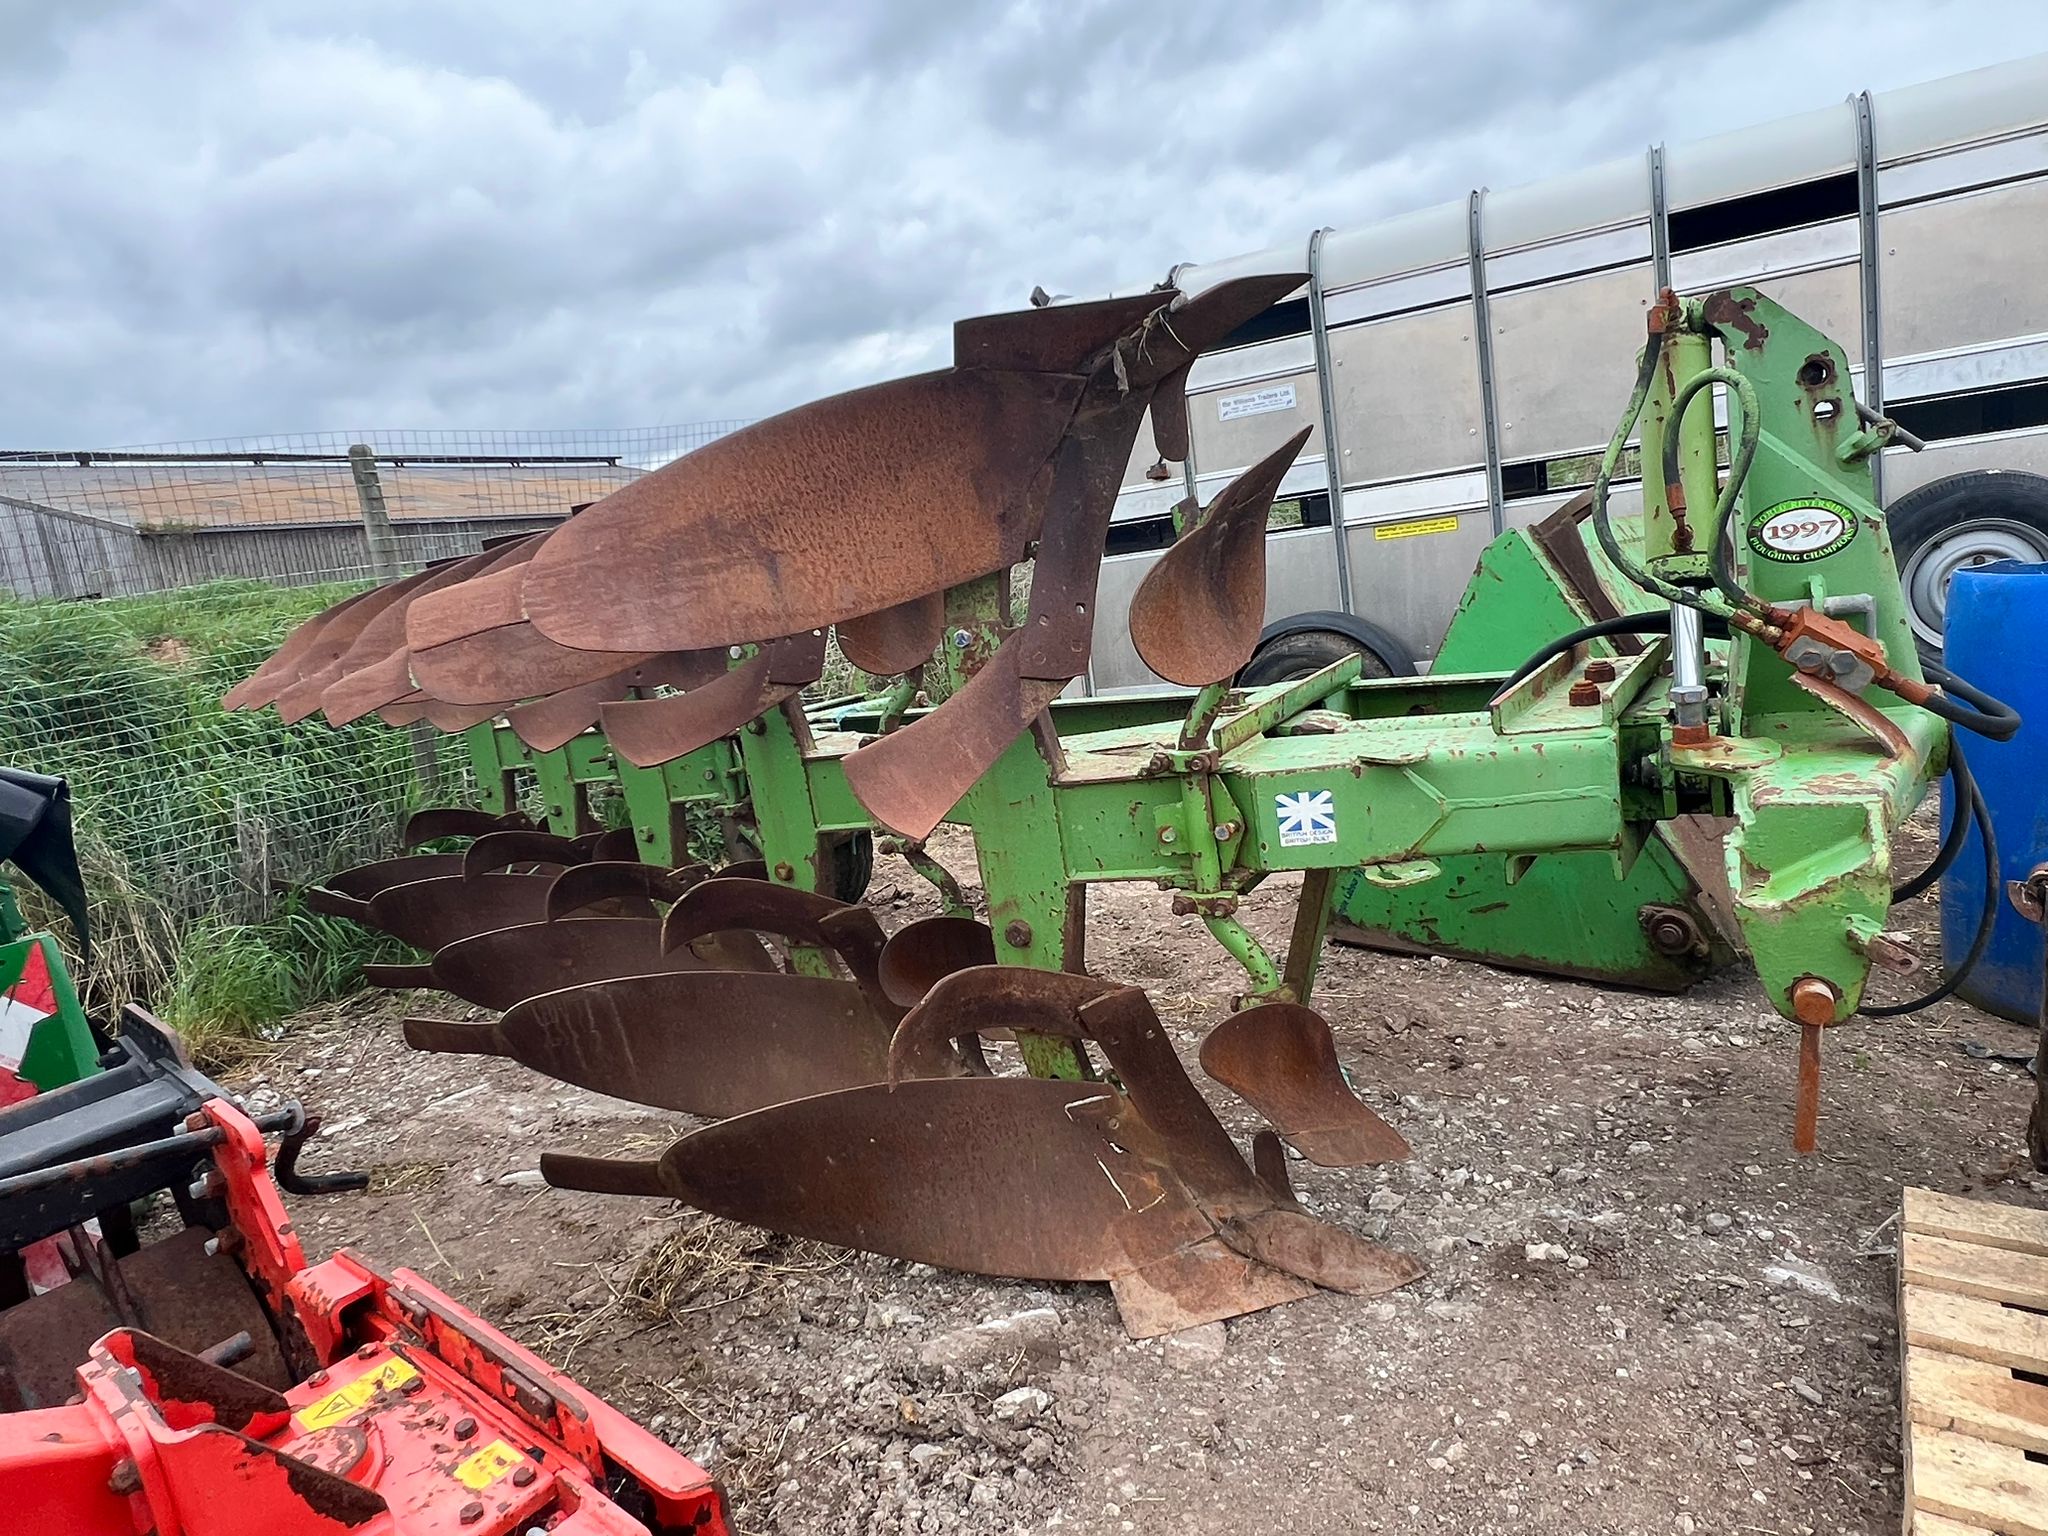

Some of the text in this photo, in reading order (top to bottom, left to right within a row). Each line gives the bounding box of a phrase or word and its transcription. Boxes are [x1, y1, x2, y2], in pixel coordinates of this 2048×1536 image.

[1766, 519, 1838, 540] 1997
[1750, 527, 1855, 561] PLOUGHING CHAMPIONS
